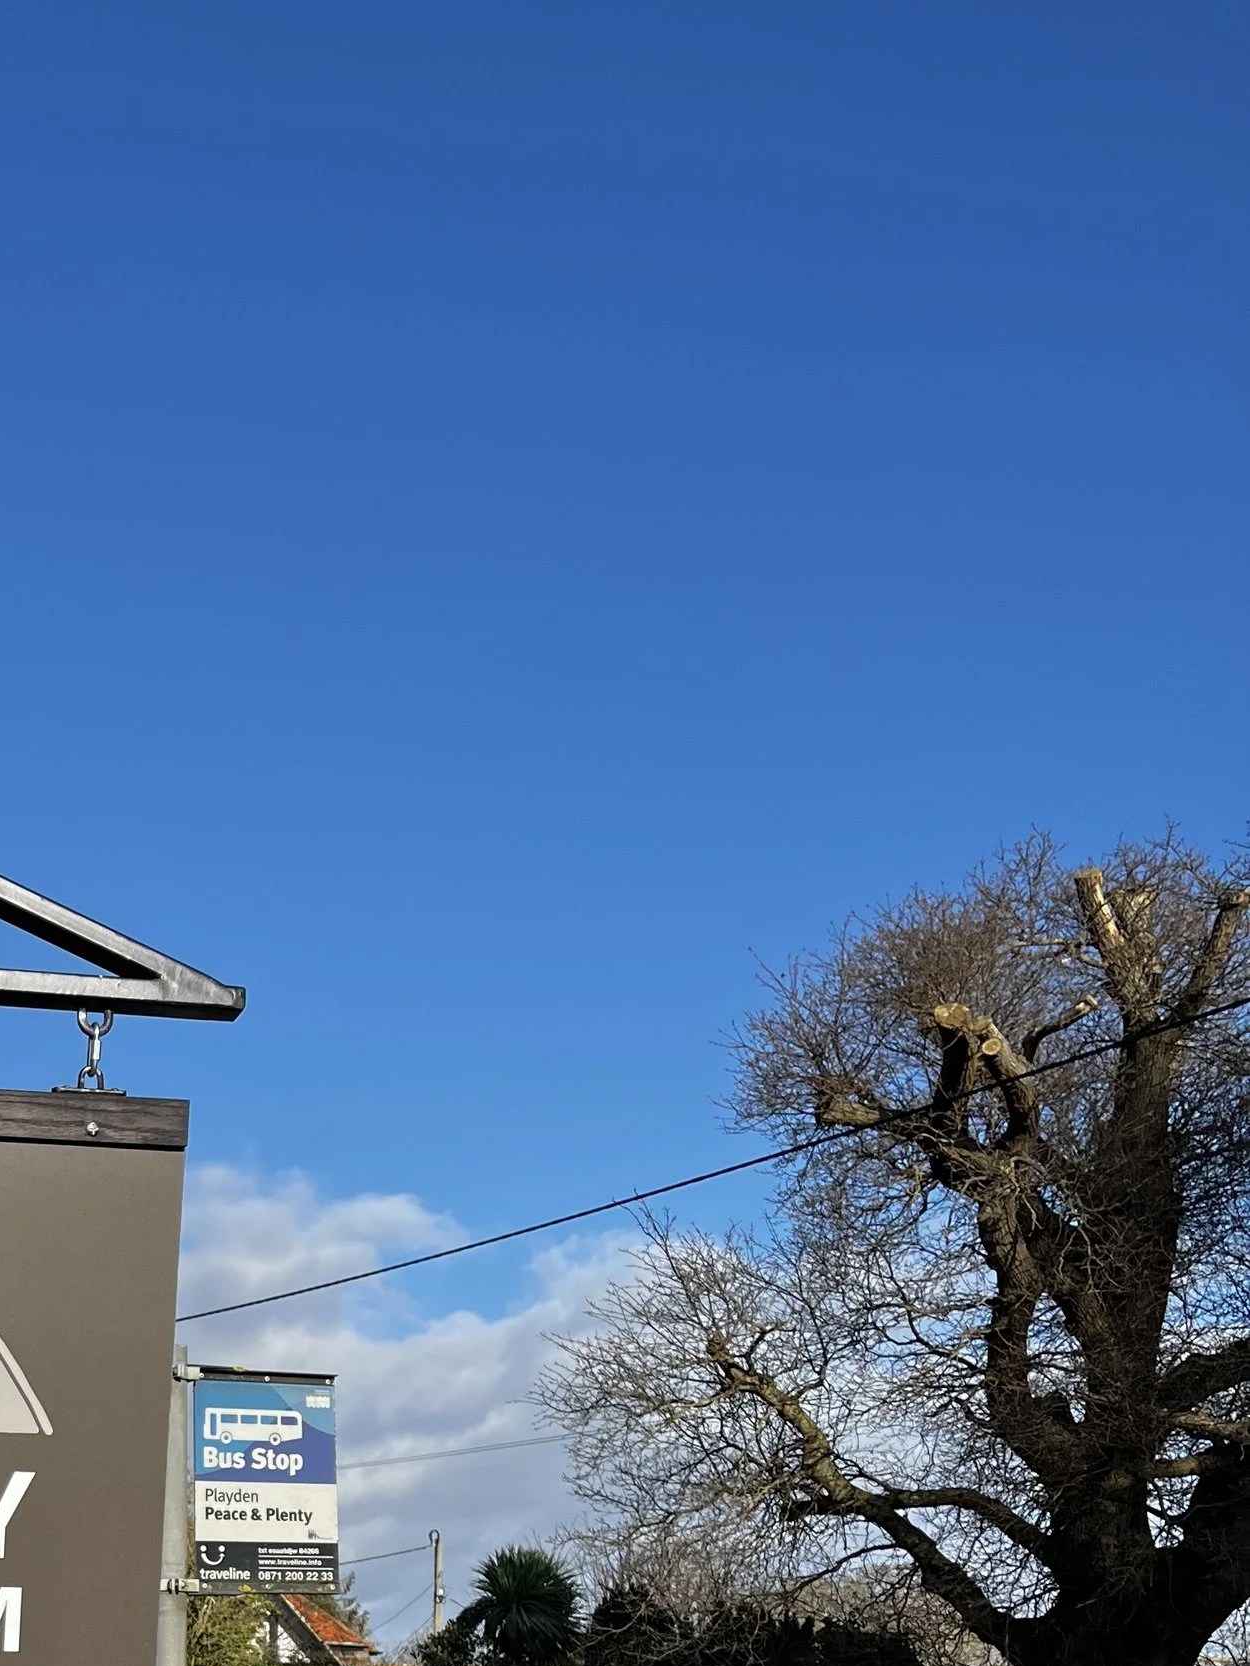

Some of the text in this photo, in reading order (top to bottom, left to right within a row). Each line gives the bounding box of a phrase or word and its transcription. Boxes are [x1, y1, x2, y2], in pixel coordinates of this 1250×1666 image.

[203, 1446, 304, 1476] Bus Stop
[205, 1488, 259, 1505] Playden
[205, 1506, 313, 1526] Peace & Plenty
[199, 1567, 251, 1580] traveline
[258, 1571, 334, 1581] 0871 200 22 33
